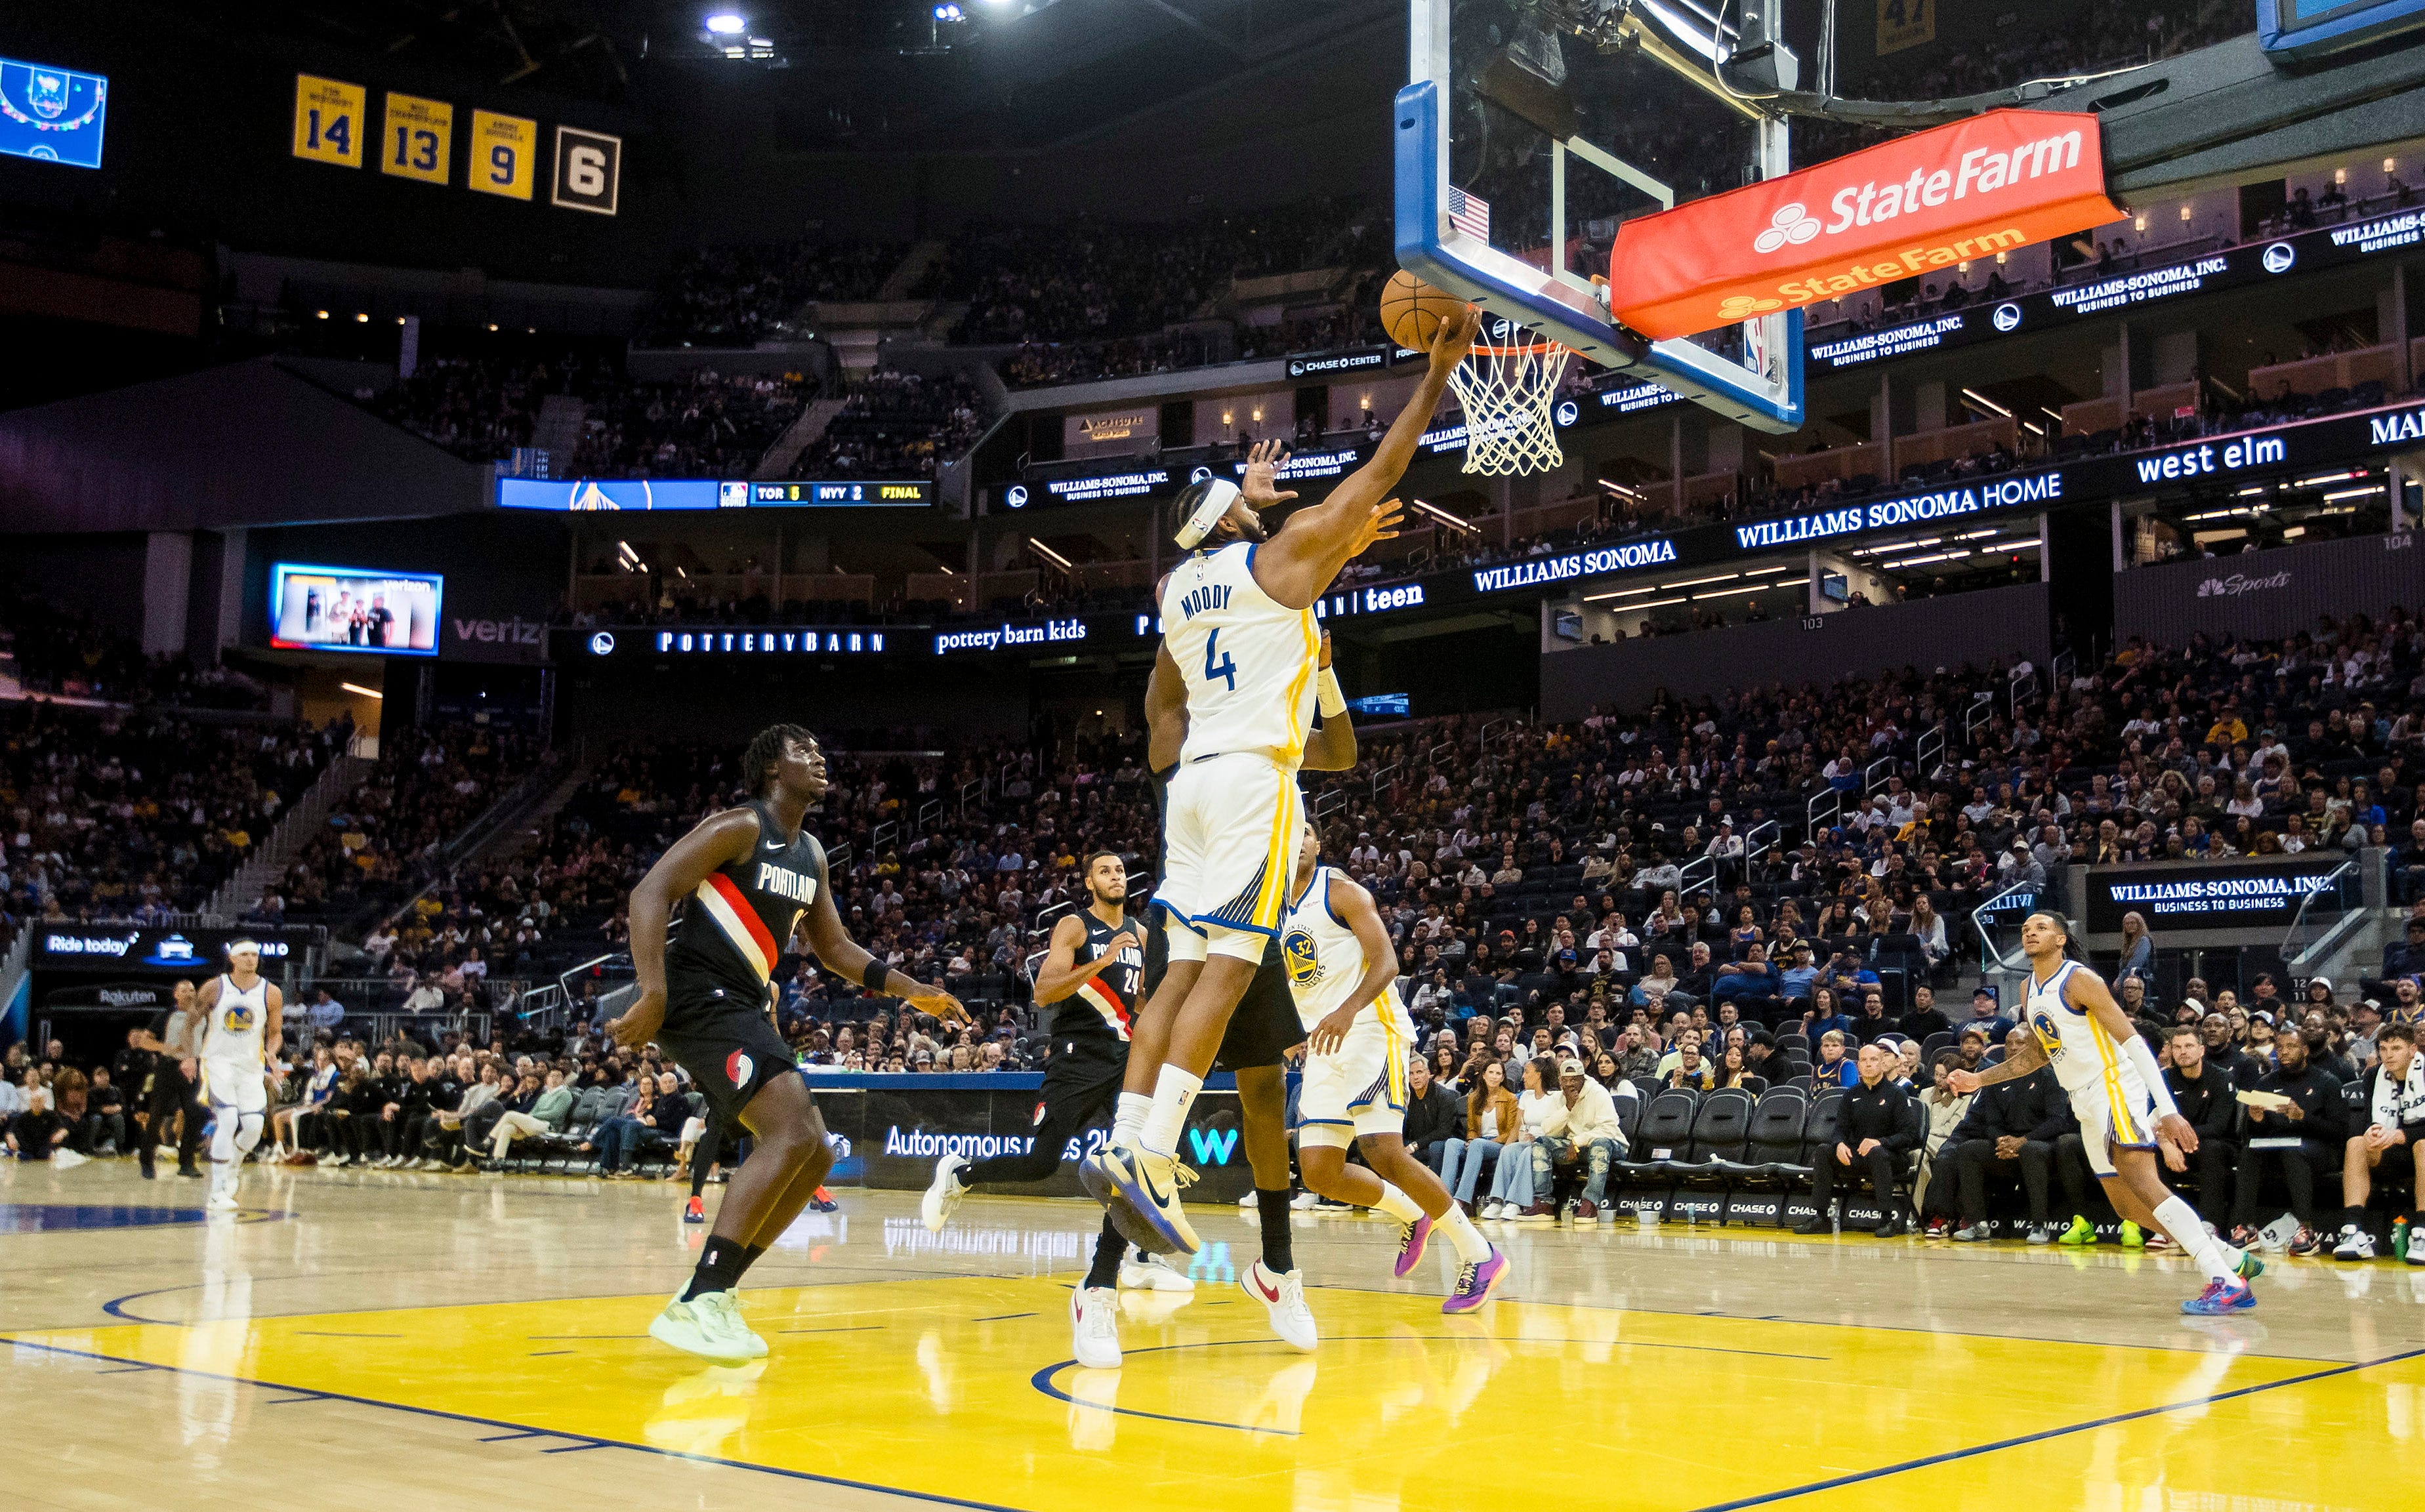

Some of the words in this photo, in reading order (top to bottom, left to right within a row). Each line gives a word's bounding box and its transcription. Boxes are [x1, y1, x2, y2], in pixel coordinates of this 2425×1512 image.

[306, 109, 350, 155] 14
[395, 127, 439, 171] 13
[491, 145, 516, 186] 9
[569, 146, 606, 197] 6
[2361, 231, 2420, 253] BUSINESS
[2077, 295, 2126, 314] BUSINESS
[2130, 291, 2145, 302] TO
[2148, 278, 2199, 298] BUSINESS
[1306, 360, 1339, 371] CHASE
[1350, 355, 1381, 366] CENTER
[1833, 349, 1876, 366] BUSINESS
[1879, 346, 1892, 356] TO
[1895, 335, 1939, 353] BUSINESS
[1621, 397, 1659, 412] BUSINESS
[1661, 394, 1672, 403] TO
[1434, 438, 1468, 453] BUSINESS
[1306, 466, 1341, 478] BUSINESS
[2137, 445, 2215, 483] west
[2224, 436, 2284, 468] elm
[757, 487, 784, 500] TOR
[820, 487, 847, 499] NYY
[853, 485, 862, 501] 2
[881, 487, 921, 499] FINAL
[1066, 490, 1101, 501] BUSINESS
[1115, 485, 1150, 496] BUSINESS
[1737, 508, 1863, 549] WILLIAMS
[1869, 489, 1978, 527] SONOMA
[1983, 474, 2060, 508] HOME
[2384, 535, 2413, 551] 104
[1474, 555, 1581, 591] WILLIAMS
[1585, 541, 1676, 574] SONOMA
[2225, 571, 2292, 597] Sports
[1180, 584, 1232, 621] MOODY
[1365, 584, 1424, 612] teen
[454, 615, 540, 645] veriz
[938, 630, 1001, 655] pottery
[1005, 624, 1045, 644] barn
[1049, 618, 1087, 641] kids
[1802, 617, 1824, 631] 103
[1205, 627, 1237, 692] 4
[757, 862, 817, 905] PORTLAND
[2155, 900, 2208, 913] BUSINESS
[2212, 900, 2225, 910] TO
[2228, 897, 2285, 909] BUSINESS
[49, 934, 83, 952] Ride
[85, 937, 129, 957] today
[1091, 943, 1142, 968] POLAND
[1296, 939, 1313, 957] 32
[1124, 968, 1140, 996] 24
[2293, 978, 2307, 989] 12
[100, 989, 157, 1005] Rakuten
[2045, 1020, 2054, 1034] 3
[886, 1125, 1021, 1158] Autonomous
[1730, 1204, 1766, 1214] CHASE
[1788, 1206, 1817, 1216] CHAS
[2013, 1219, 2070, 1231] WMO
